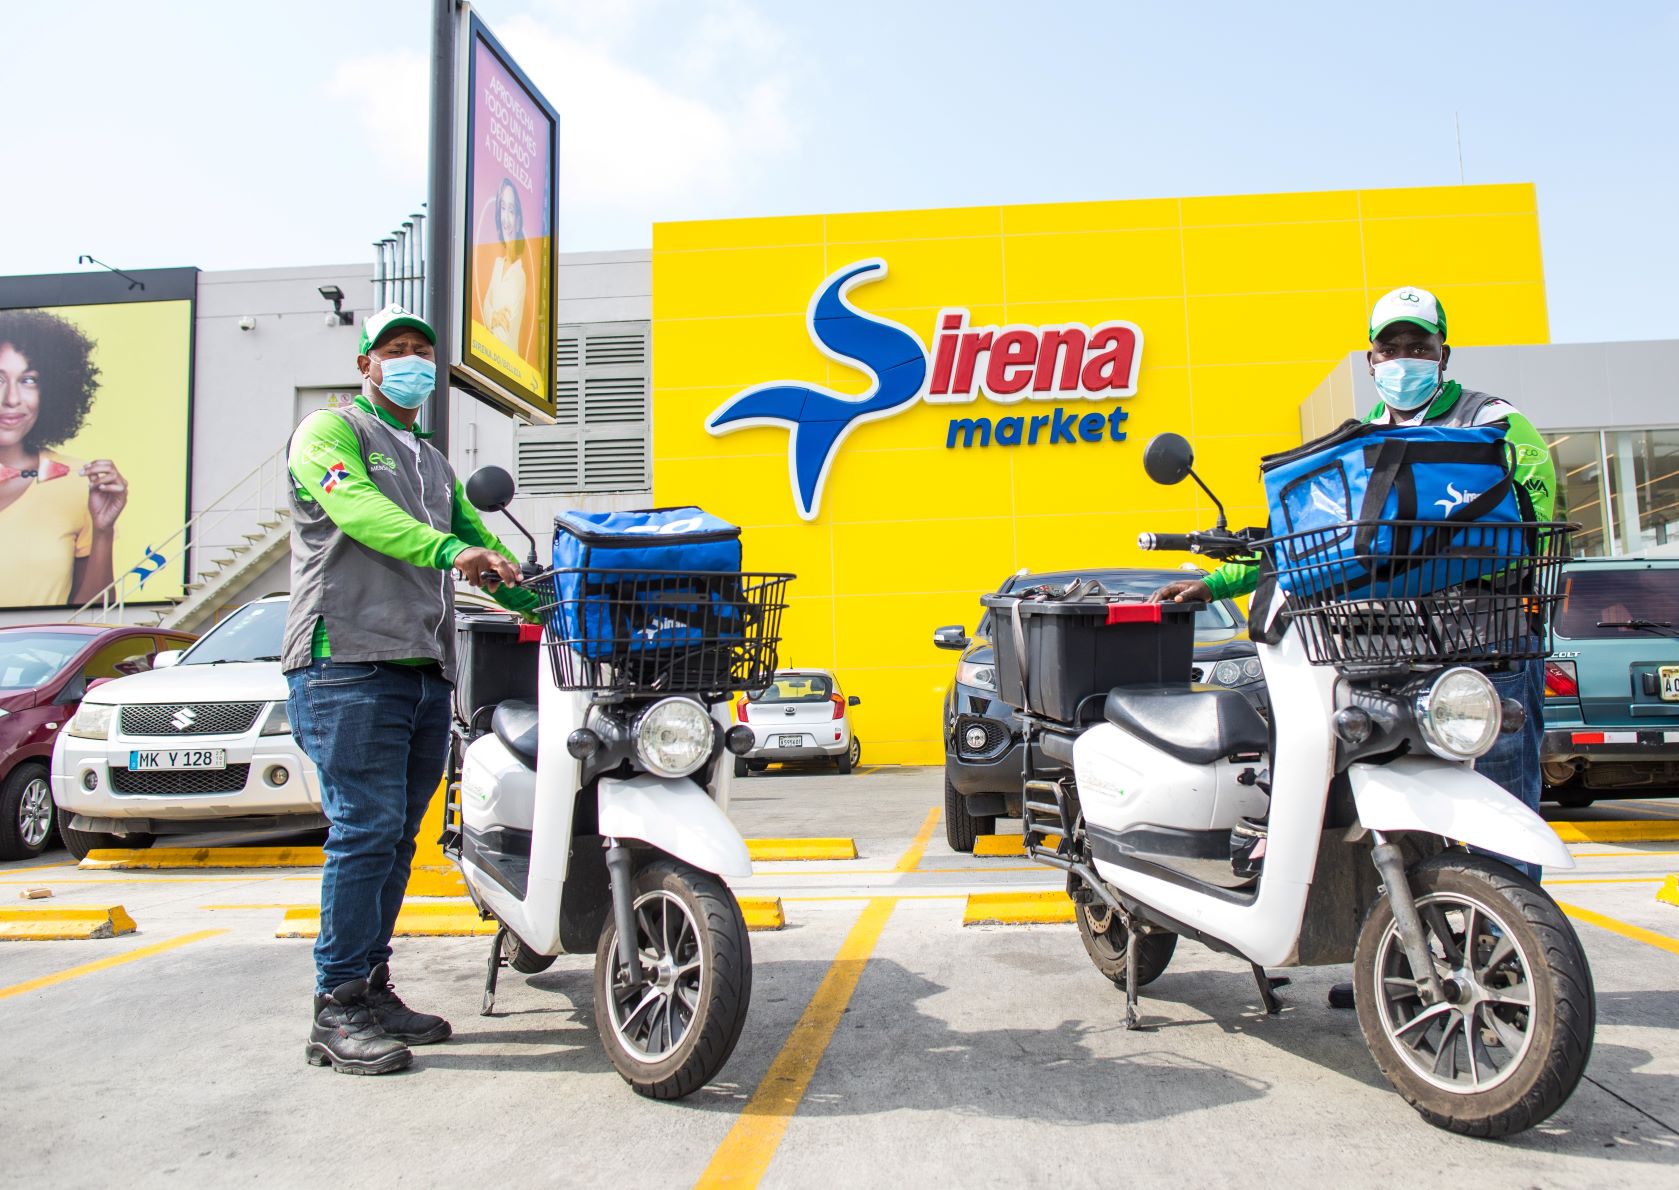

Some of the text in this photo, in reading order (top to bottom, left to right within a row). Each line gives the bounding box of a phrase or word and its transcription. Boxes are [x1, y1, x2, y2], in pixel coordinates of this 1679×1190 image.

[484, 88, 537, 157] TODO UN MES
[490, 76, 535, 134] APROVECHA
[485, 134, 533, 193] A TU BELLEZA
[490, 118, 530, 168] DEDICADO
[704, 256, 1145, 522] Sirena
[946, 406, 1129, 448] market
[139, 752, 160, 767] MK
[169, 752, 178, 767] Y
[183, 751, 212, 766] 128
